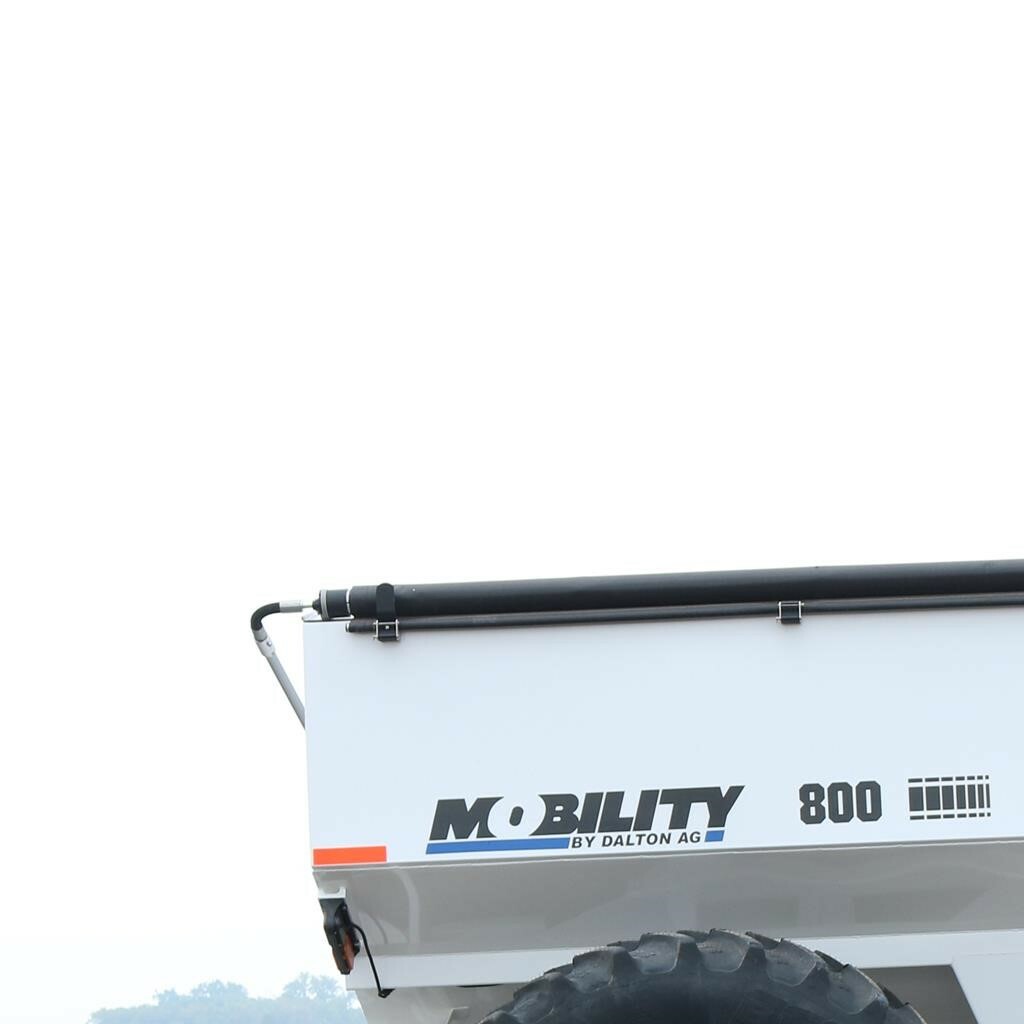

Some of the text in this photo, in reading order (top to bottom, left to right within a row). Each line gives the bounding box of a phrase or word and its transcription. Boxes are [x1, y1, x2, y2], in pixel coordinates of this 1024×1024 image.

[429, 785, 745, 841] MOBILITY
[799, 780, 882, 825] 800
[571, 831, 702, 849] BY DALTON AG
